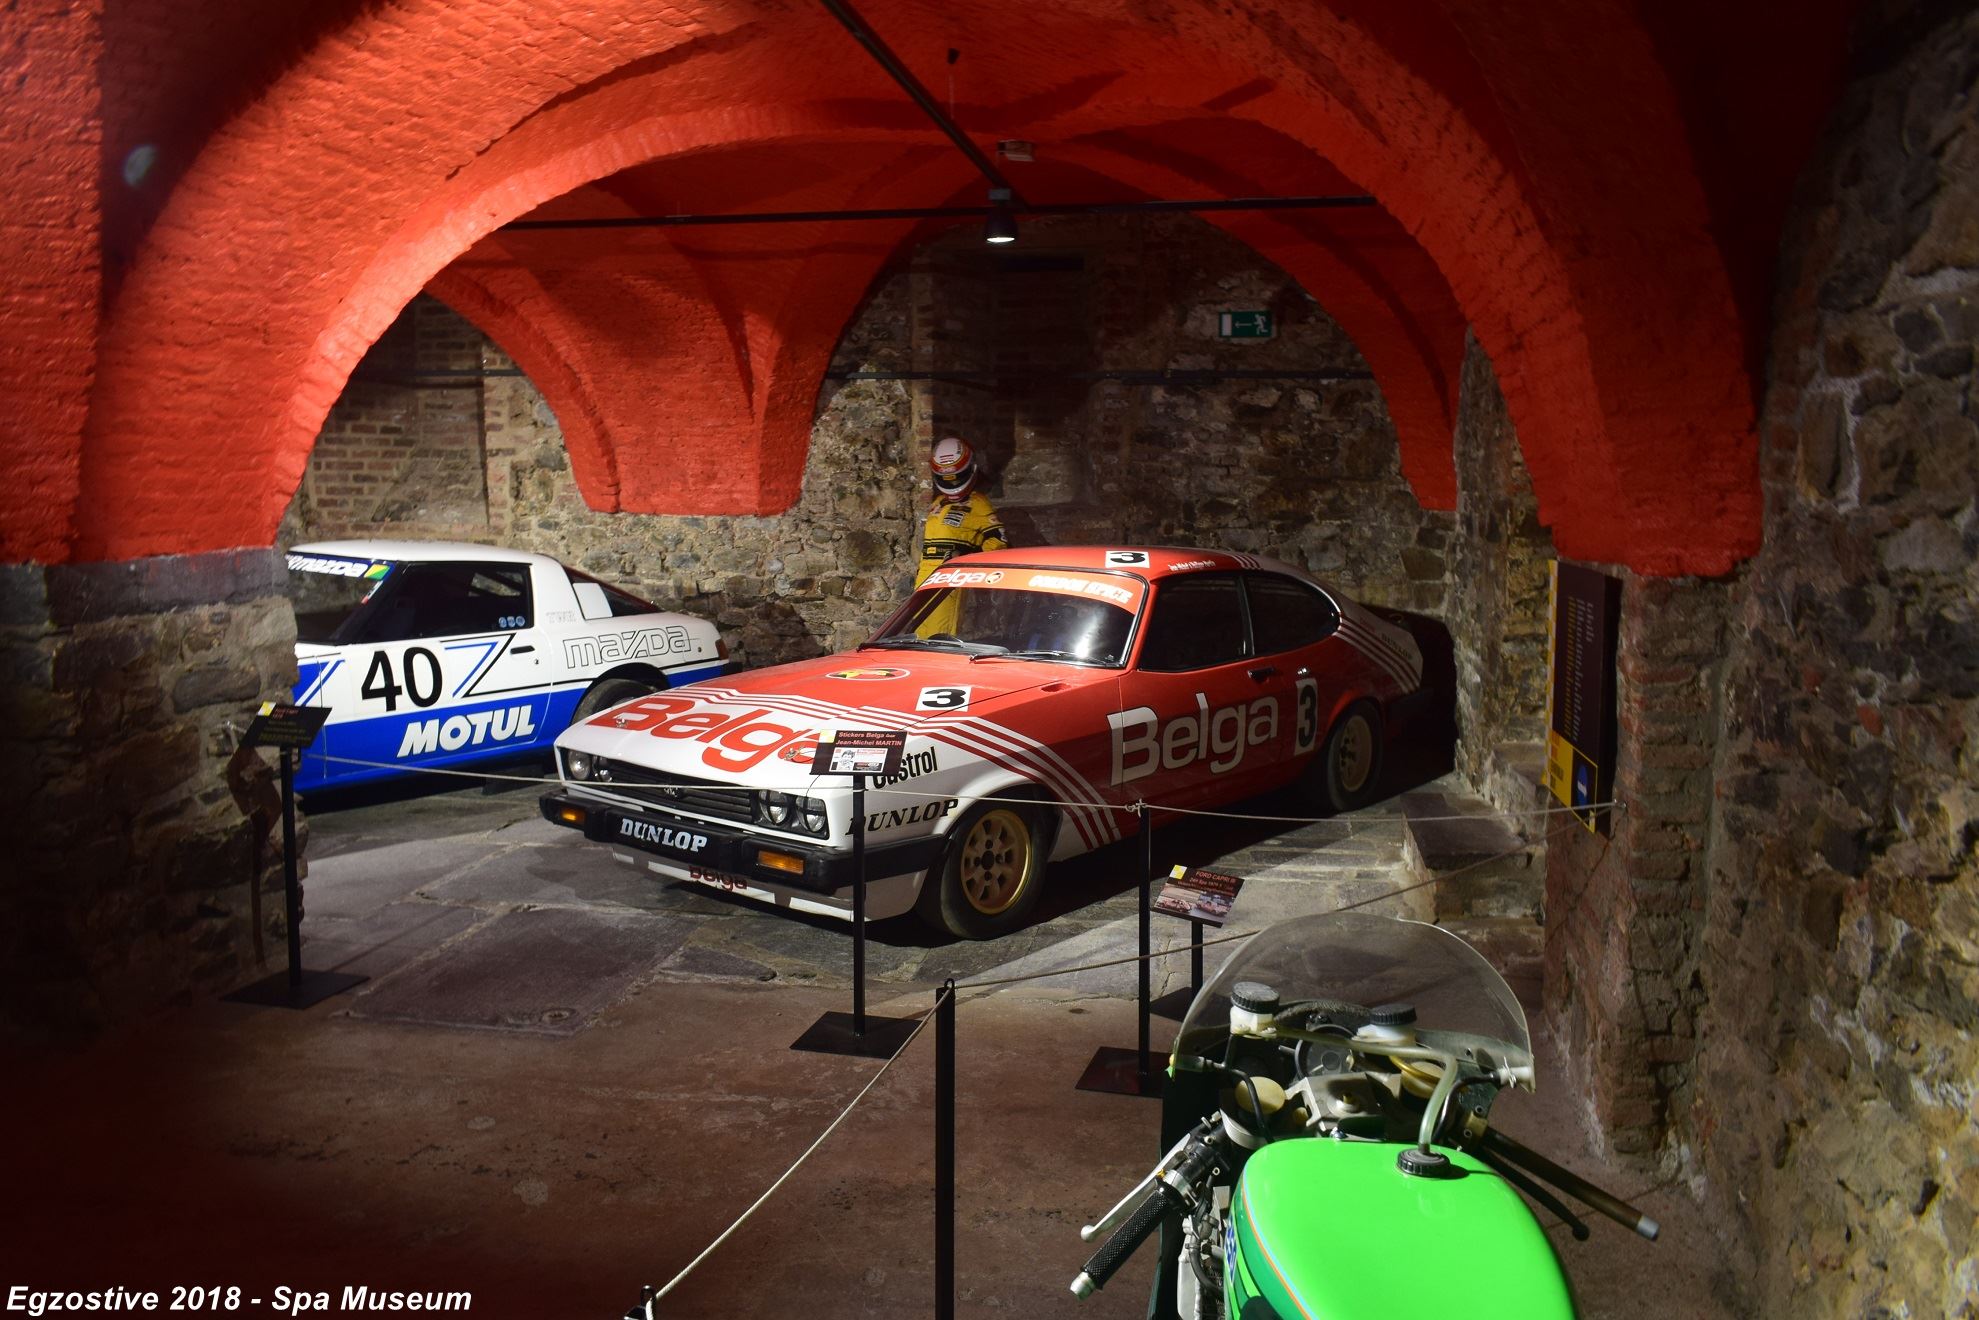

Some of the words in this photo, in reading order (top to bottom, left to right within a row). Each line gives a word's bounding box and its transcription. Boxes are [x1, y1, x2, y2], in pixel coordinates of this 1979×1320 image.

[1110, 552, 1146, 564] 3
[920, 569, 986, 587] Belga
[361, 646, 443, 712] 40
[922, 688, 967, 708] 3
[396, 704, 535, 758] MOTUL
[1298, 684, 1317, 748] 3
[866, 732, 885, 740] Belga
[1106, 692, 1279, 786] Belga
[620, 818, 708, 853] DUNLOP
